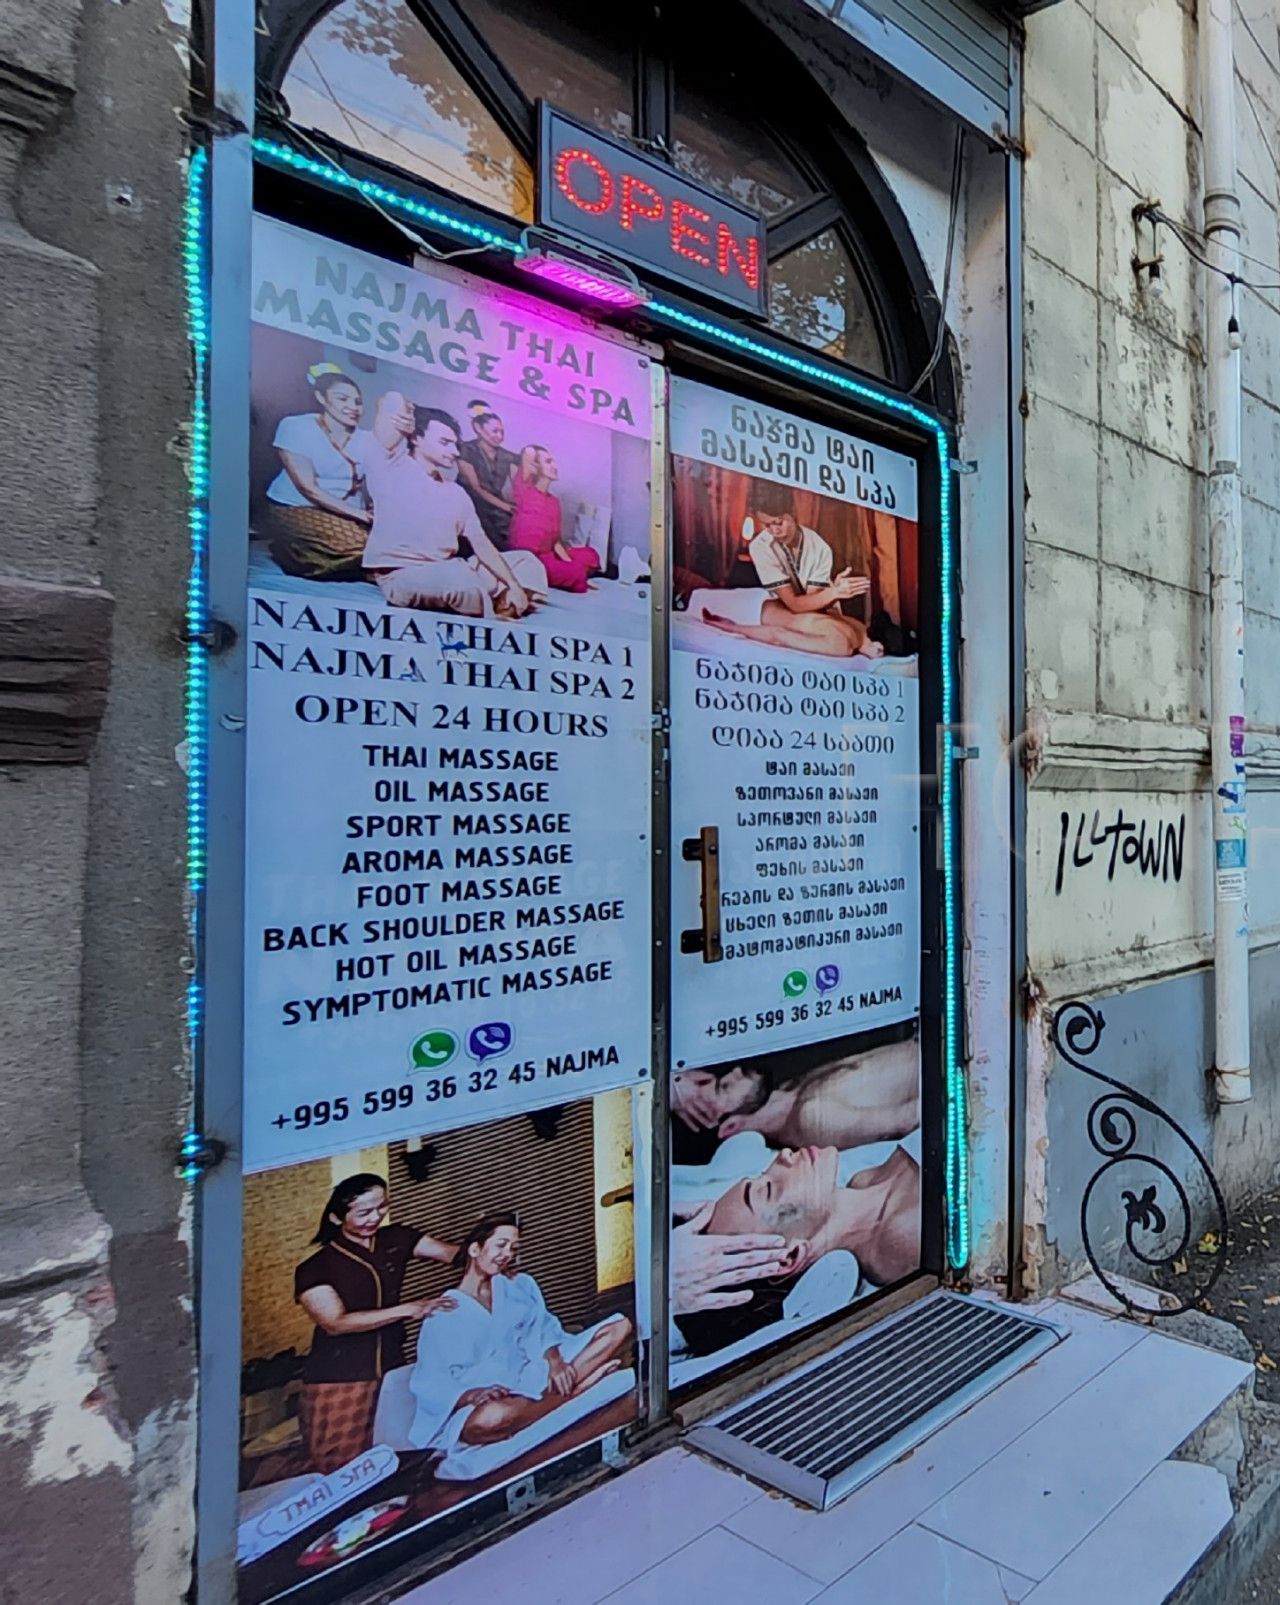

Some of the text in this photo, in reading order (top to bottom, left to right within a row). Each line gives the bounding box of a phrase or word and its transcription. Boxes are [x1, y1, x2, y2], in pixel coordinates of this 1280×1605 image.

[554, 149, 759, 289] OPEN
[315, 256, 594, 377] NAJMA THAI
[254, 281, 635, 426] MASSAGE & SPA
[731, 405, 873, 474] ნაჯმა ტაი
[702, 428, 895, 509] მასაჟი და სპა
[251, 597, 633, 667] NAJMA THAI SPA 1
[251, 641, 635, 699] NAJMA THAI SPA 2
[802, 671, 845, 692] ტაი
[853, 676, 889, 697] სპა
[896, 681, 904, 698] 1
[296, 695, 608, 738] OPEN 24 HOURS
[801, 698, 844, 718] ტაი
[852, 701, 889, 722] სპა
[895, 705, 904, 723] 2
[712, 725, 894, 753] ღიაა 24 საათი
[363, 745, 559, 771] THAI MASSAGE
[766, 761, 855, 776] ტაი მასაჟი
[375, 780, 549, 802] OIL MASSAGE
[735, 786, 878, 801] ზეთოვანი მასაჟი
[346, 813, 571, 838] SPORT MASSAGE
[737, 810, 877, 827] სპორტული მასაჟი
[756, 834, 864, 852] არომა მასაჟი
[342, 844, 573, 874] AROMA MASSAGE
[756, 858, 864, 878] ფეხის მასაჟი
[357, 875, 561, 908] FOOT MASSAGE
[778, 886, 794, 902] და
[800, 882, 853, 899] ზურგის
[858, 878, 905, 894] მასაჟი
[263, 900, 625, 952] BACK SHOULDER MASSAGE
[726, 902, 888, 933] ცხელი ზეთის მასაჟი
[855, 922, 903, 941] მასაჟი
[336, 935, 576, 981] HOT OIL MASSAGE
[282, 961, 612, 1026] SYMPTOMATIC MASSAGE
[705, 986, 902, 1038] +995 599 36 32 45 NAJMA
[272, 1045, 619, 1130] +995 599 36 32 45 NAJMA
